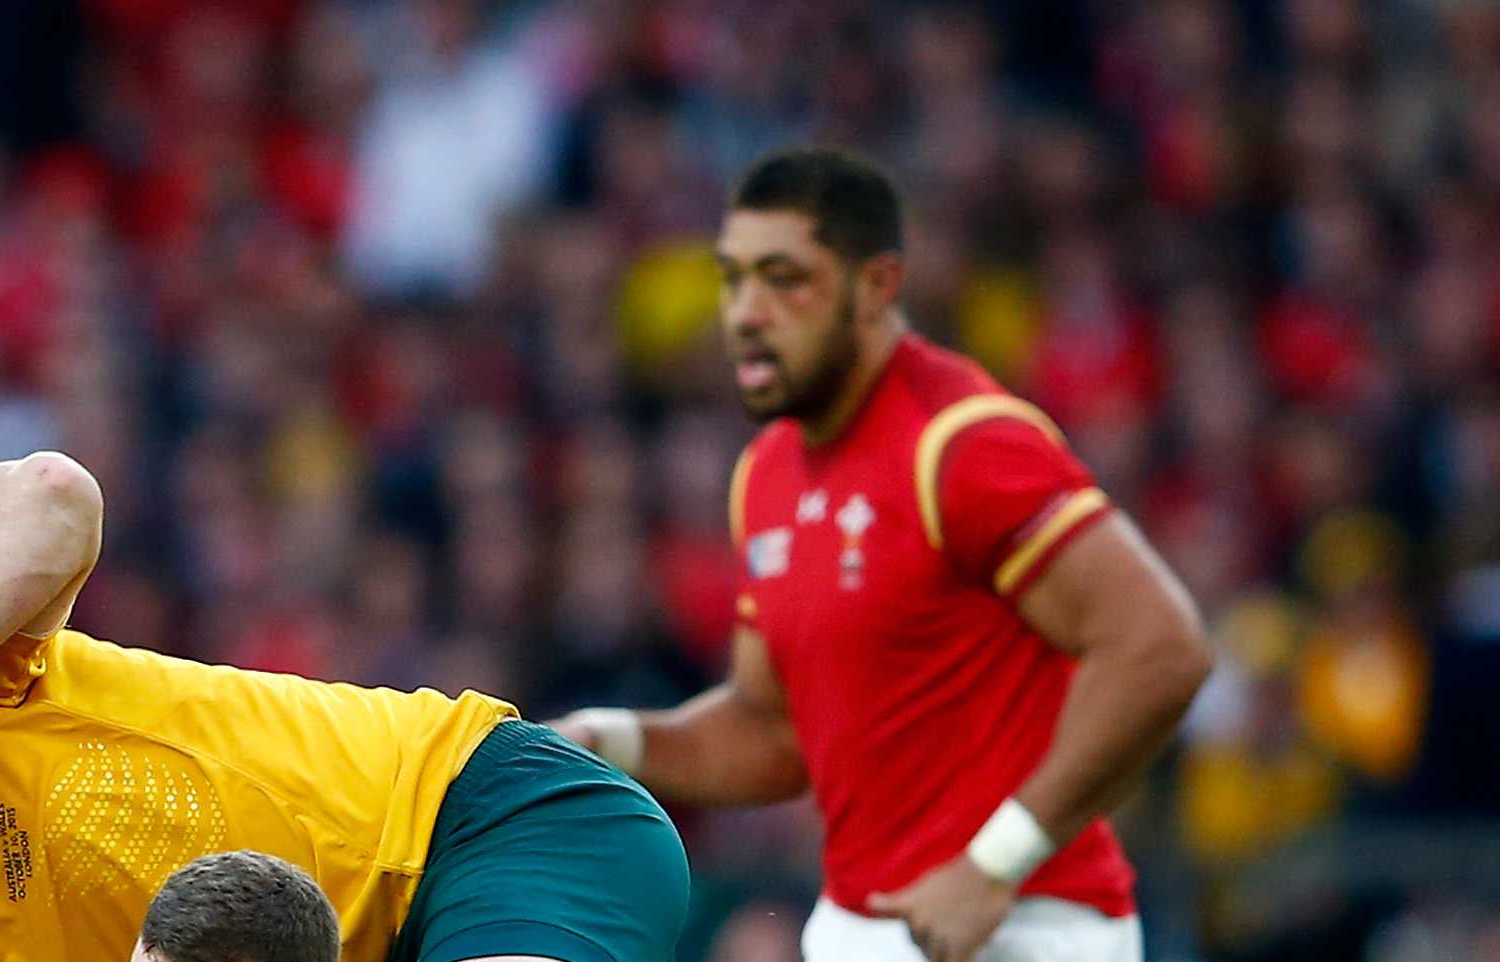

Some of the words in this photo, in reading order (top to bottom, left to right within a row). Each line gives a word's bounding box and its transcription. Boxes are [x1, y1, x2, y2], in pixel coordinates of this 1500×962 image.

[6, 807, 17, 830] 2015
[2, 848, 18, 903] AUSTRALIA
[11, 851, 27, 900] OCTOBER
[20, 831, 33, 877] LONDON
